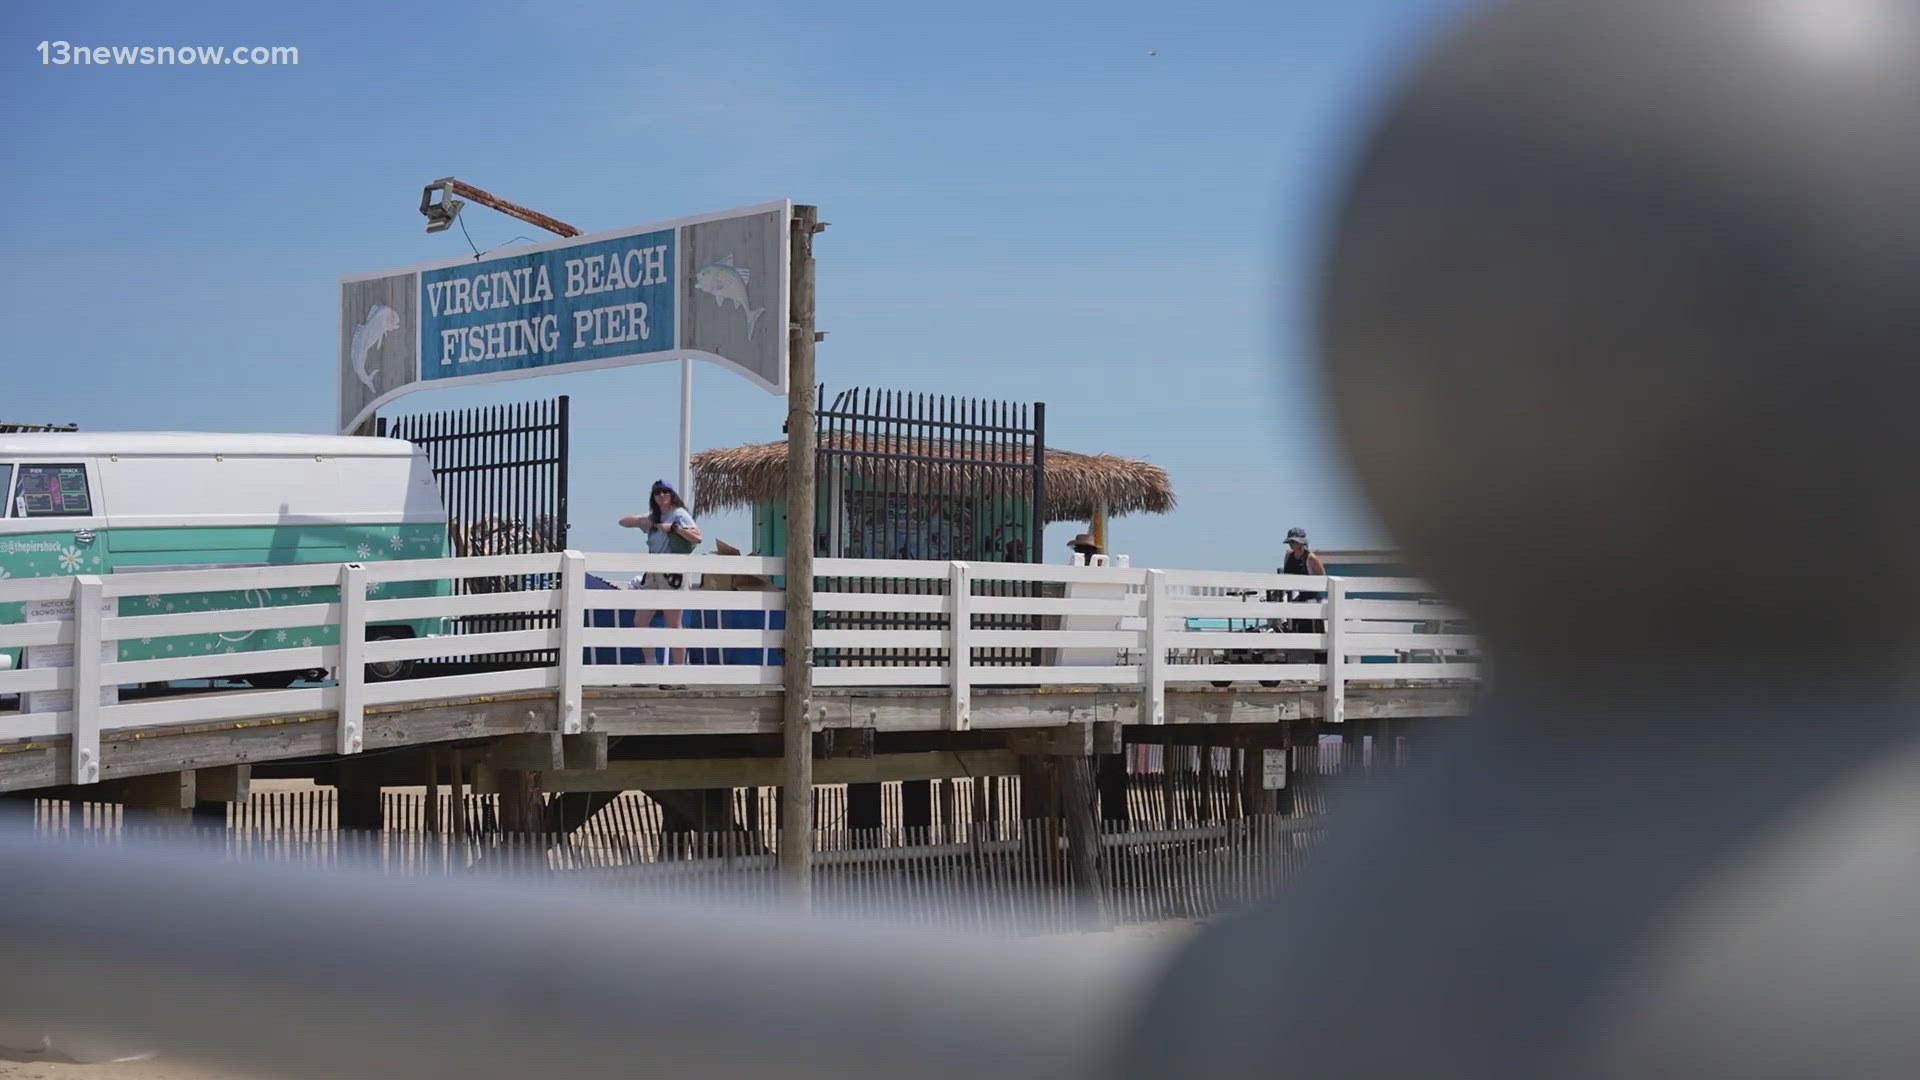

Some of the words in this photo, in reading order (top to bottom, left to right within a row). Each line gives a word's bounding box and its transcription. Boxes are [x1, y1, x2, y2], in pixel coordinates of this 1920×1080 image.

[427, 264, 553, 317] VIRGINIA
[564, 245, 667, 297] BEACH
[440, 314, 560, 365] FISHING
[573, 302, 649, 348] PIER
[40, 600, 64, 608] NOTICE
